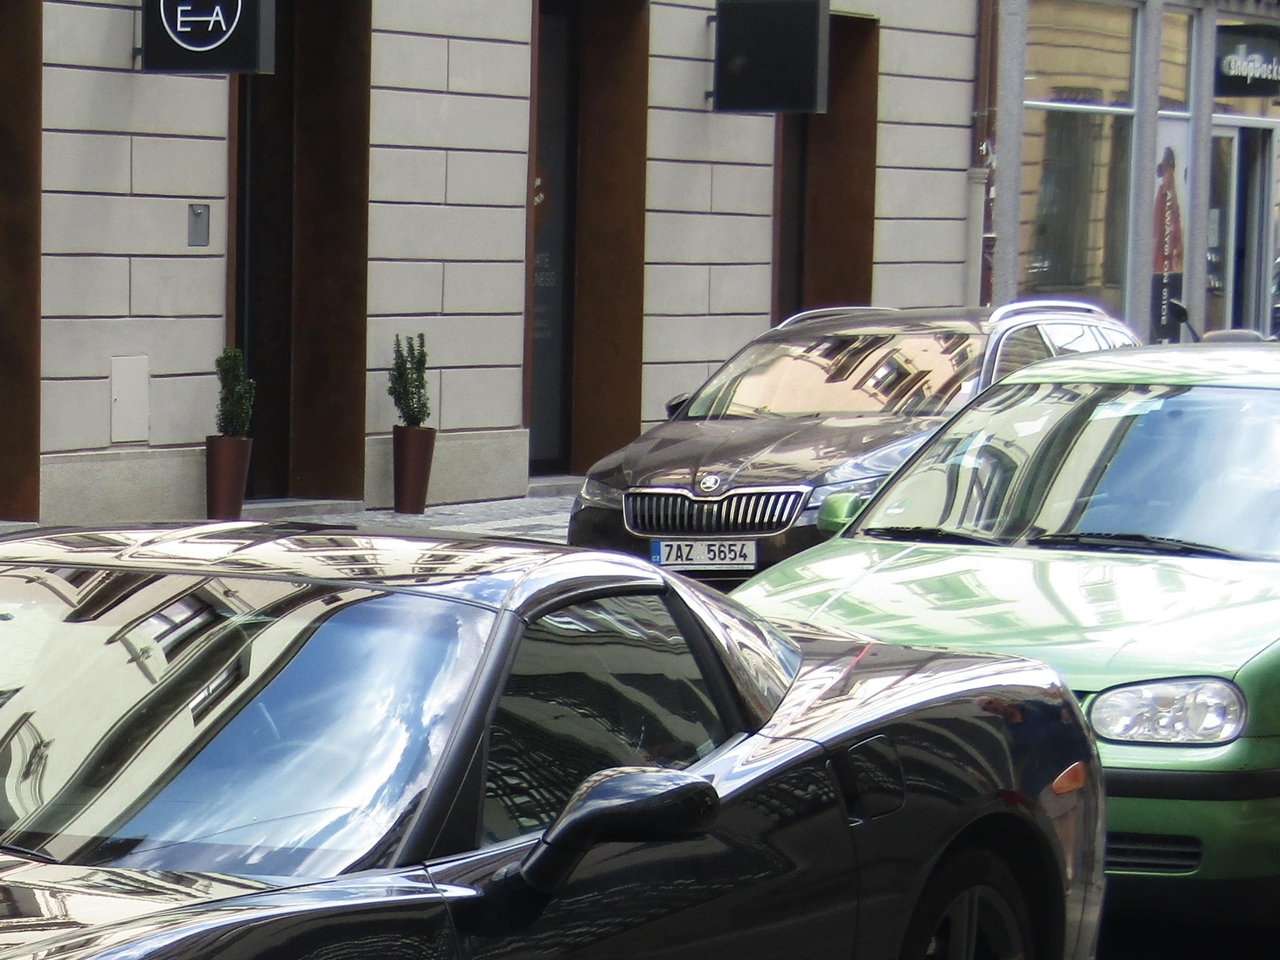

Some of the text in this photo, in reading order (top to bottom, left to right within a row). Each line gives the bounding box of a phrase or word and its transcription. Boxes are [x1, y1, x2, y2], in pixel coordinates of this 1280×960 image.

[1164, 190, 1172, 256] ALWAYS
[533, 271, 555, 286] NESS
[1162, 261, 1170, 283] ON
[664, 543, 748, 561] 7AZ 5654
